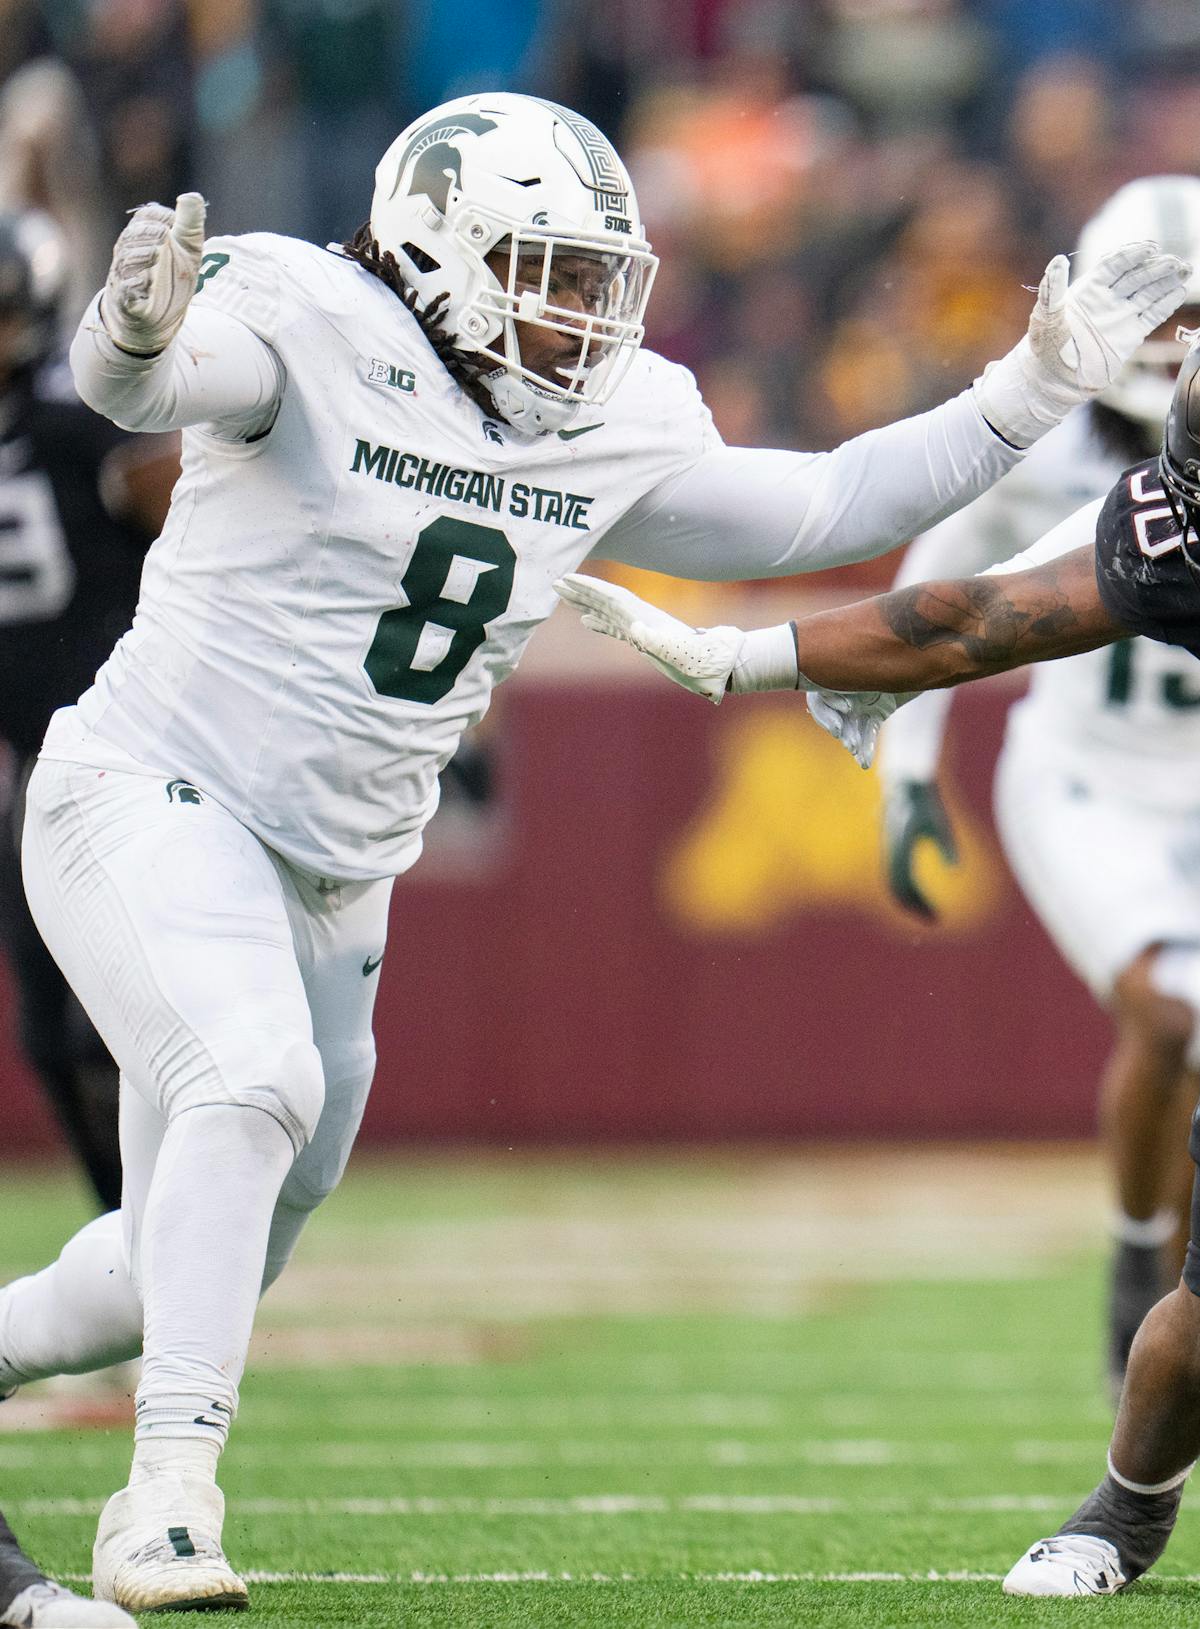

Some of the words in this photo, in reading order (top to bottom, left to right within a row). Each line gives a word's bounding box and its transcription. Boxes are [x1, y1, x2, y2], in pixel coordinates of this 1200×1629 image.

[604, 215, 633, 235] STATE
[349, 438, 505, 513] MICHIGAN
[509, 482, 595, 531] STATE
[363, 515, 517, 706] 8
